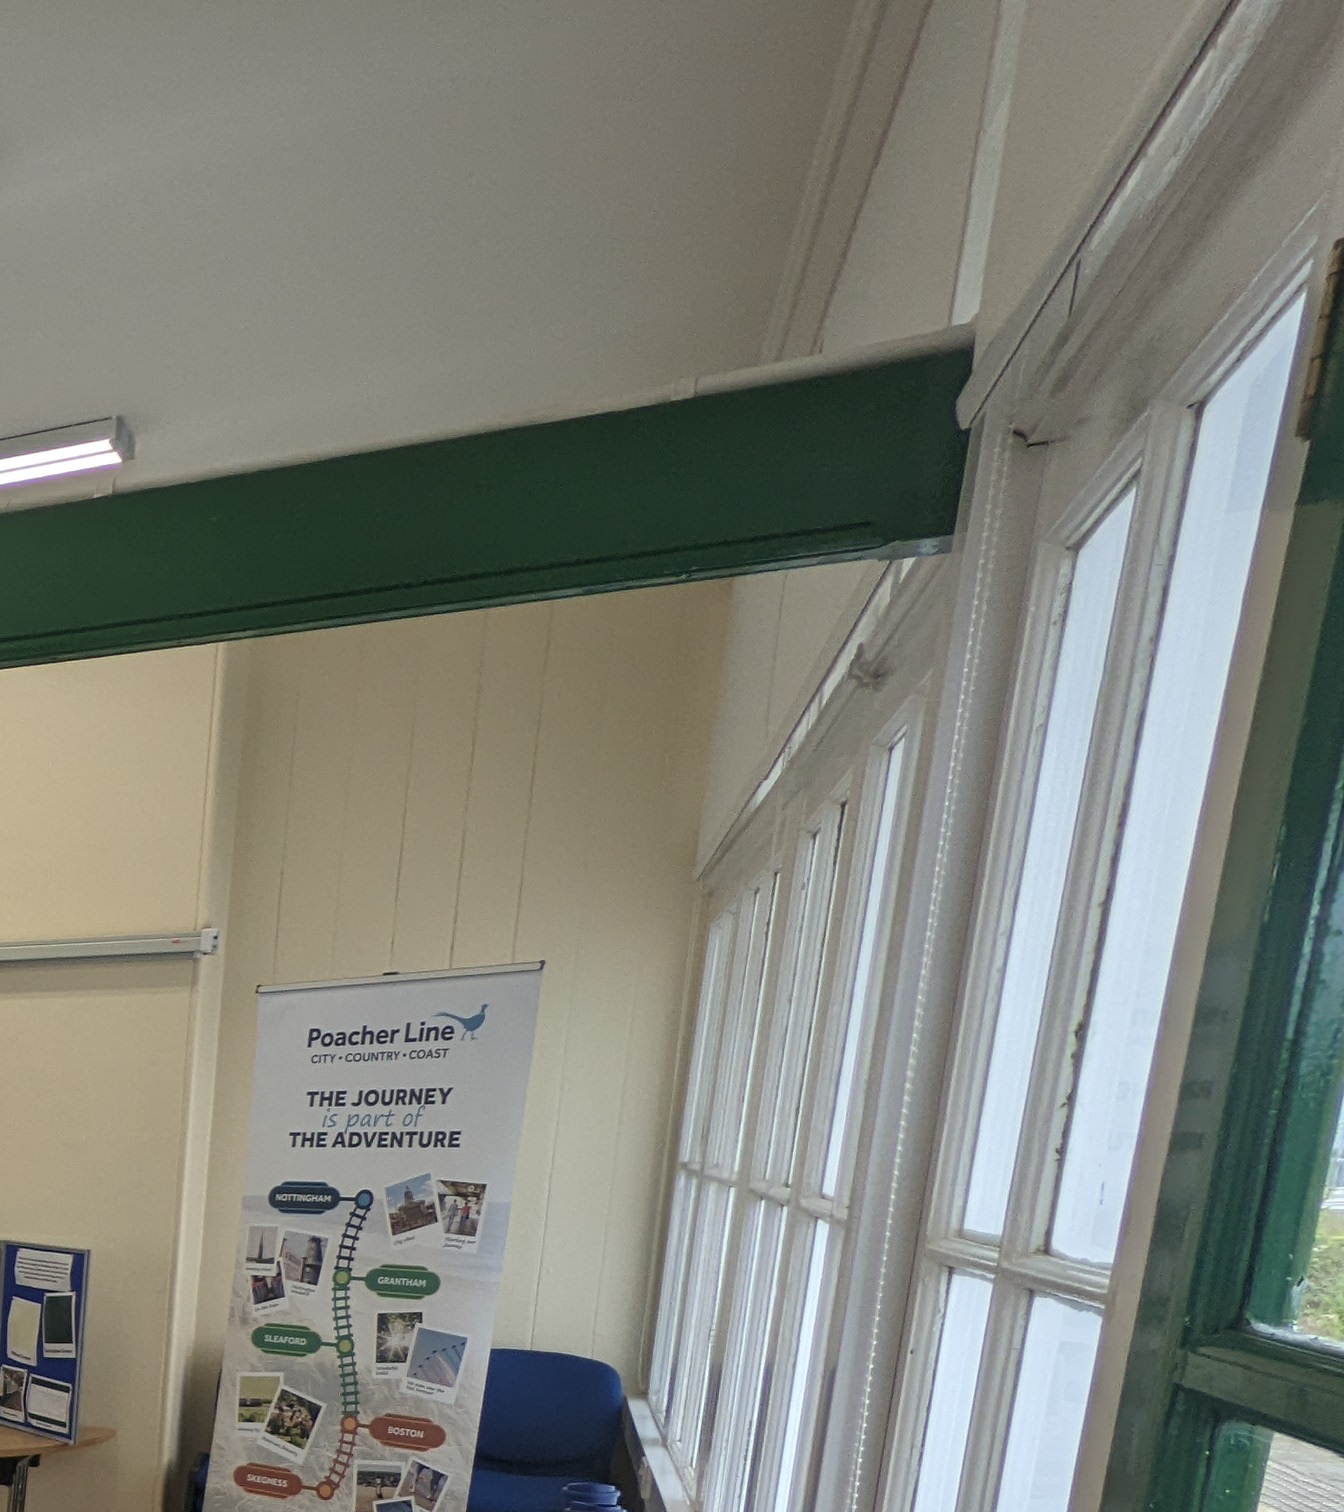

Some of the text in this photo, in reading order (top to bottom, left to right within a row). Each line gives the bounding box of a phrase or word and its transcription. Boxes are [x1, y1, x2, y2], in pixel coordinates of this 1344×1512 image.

[307, 1021, 455, 1048] Poacher Line
[311, 1048, 450, 1064] CITY COUNTRY COAST
[306, 1087, 453, 1108] THE JOURNEY
[322, 1105, 426, 1132] is part of
[289, 1130, 462, 1148] THE ADVENTURE
[275, 1192, 332, 1204] NOTTINGHAM
[377, 1276, 426, 1287] GRANTHAM
[264, 1333, 307, 1346] SLEAFORD
[388, 1425, 424, 1439] BOSTON
[246, 1473, 288, 1488] SKEGNESS
